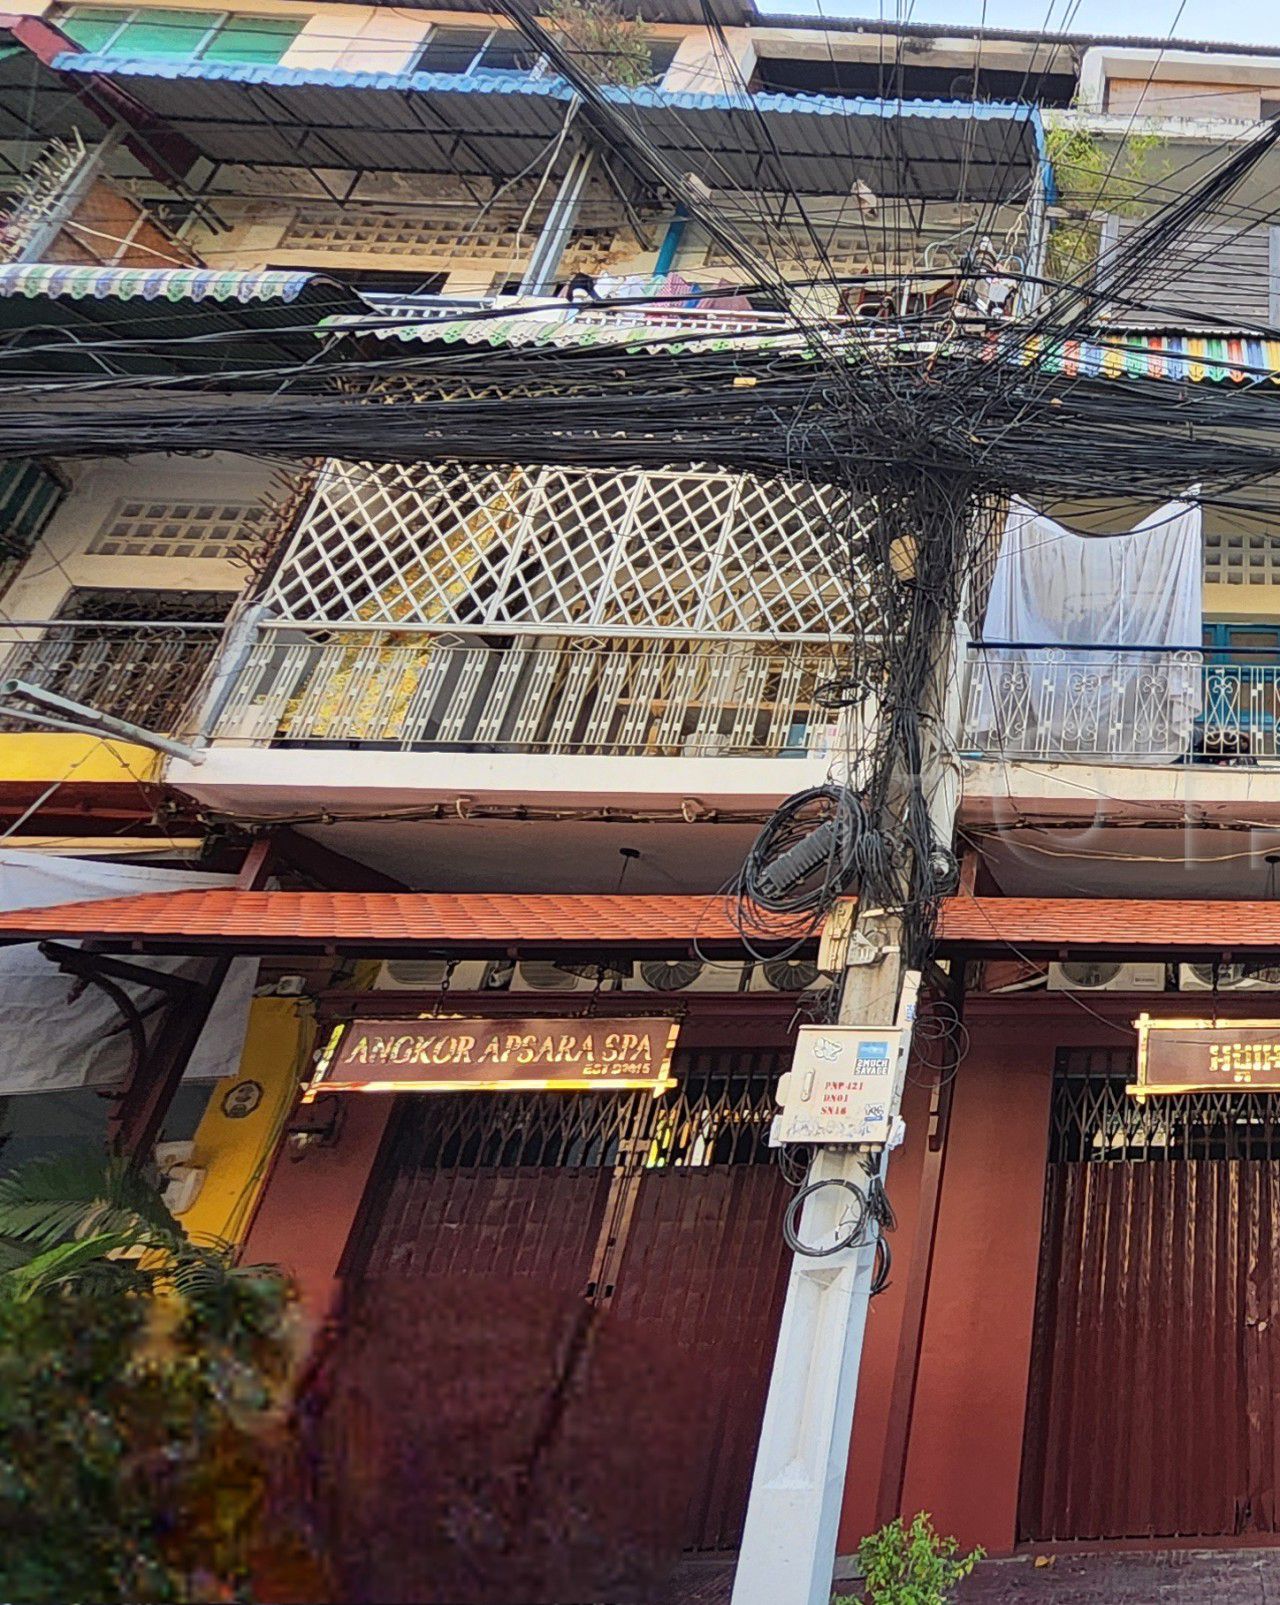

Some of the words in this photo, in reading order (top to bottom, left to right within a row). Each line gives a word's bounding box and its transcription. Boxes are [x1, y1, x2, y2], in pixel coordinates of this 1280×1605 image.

[344, 1035, 475, 1064] ANGKOR
[477, 1034, 595, 1063] APSARA
[600, 1033, 652, 1062] SPA
